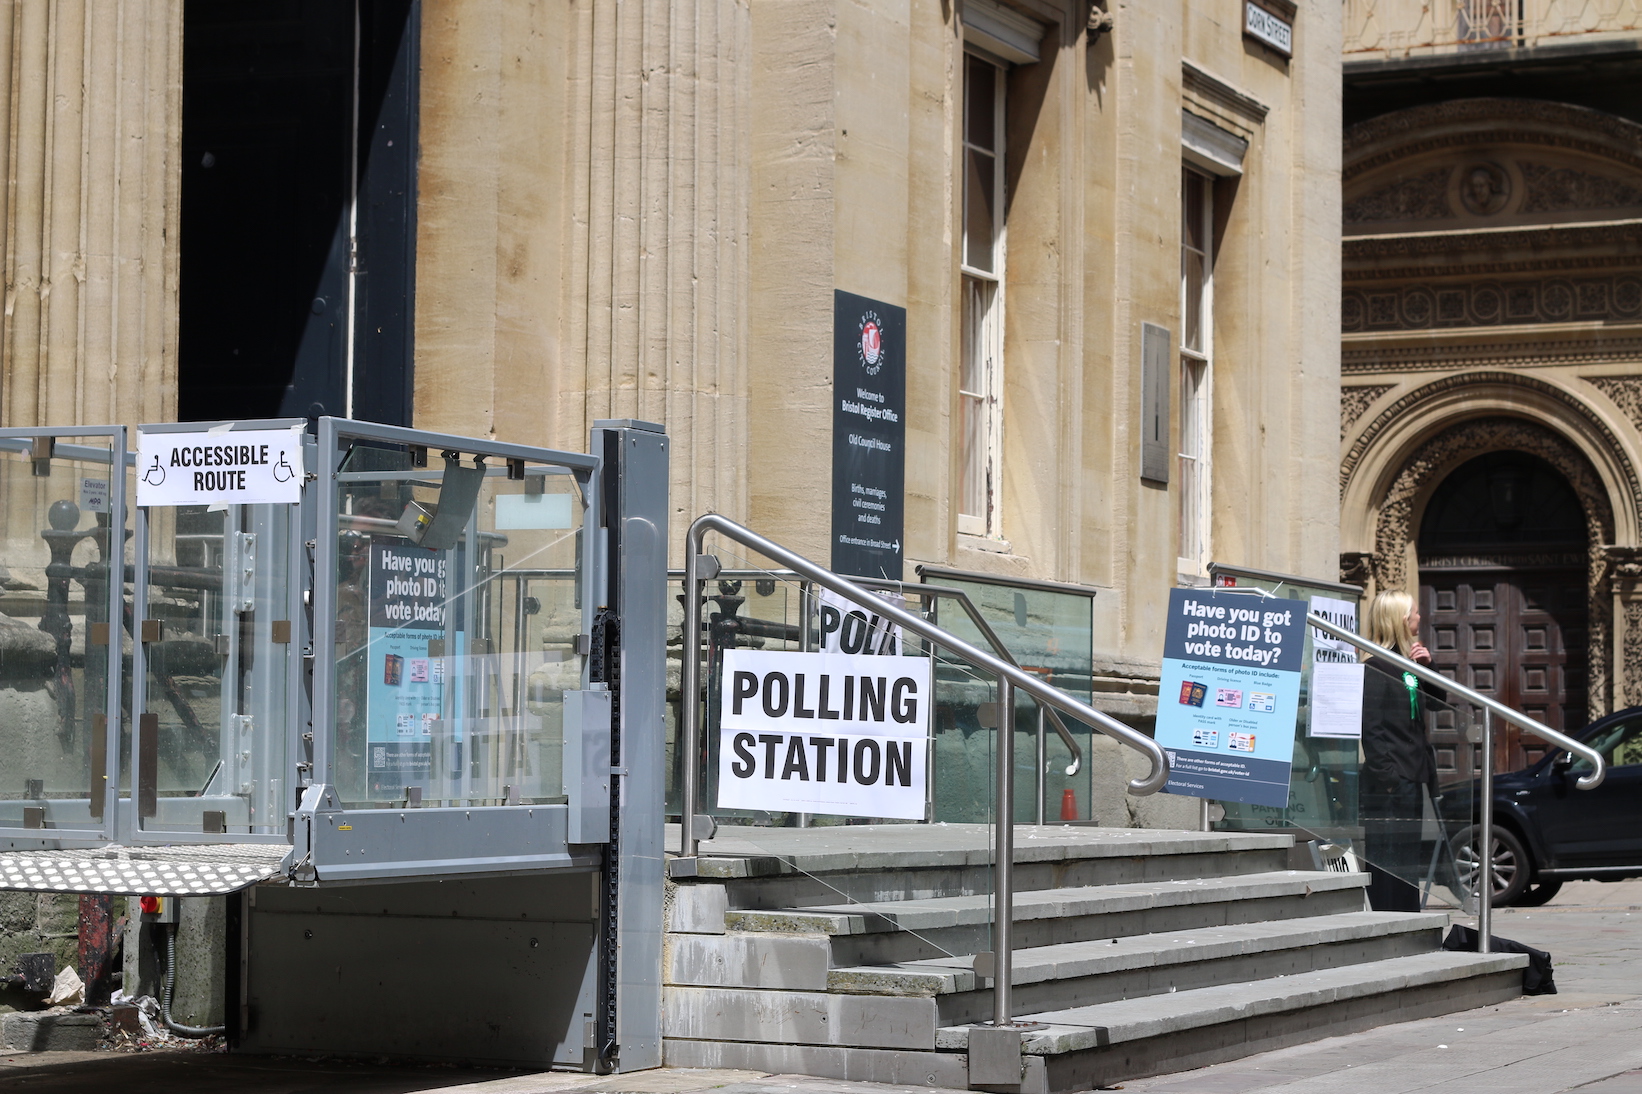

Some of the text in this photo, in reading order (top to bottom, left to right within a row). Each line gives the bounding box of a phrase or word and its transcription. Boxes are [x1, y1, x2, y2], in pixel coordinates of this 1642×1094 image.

[1248, 6, 1289, 47] CORN STREET
[859, 310, 884, 335] BRISTOL
[857, 342, 885, 376] CITY COUNCIL
[856, 387, 885, 403] Welcome to
[842, 400, 898, 422] Bristol Register Office
[849, 434, 891, 451] Old Council House
[170, 445, 268, 467] ACCESSIBLE
[84, 480, 106, 489] Elevator
[194, 470, 246, 491] ROUTE
[851, 483, 887, 499] Births, marriages,
[853, 498, 885, 511] civil ceremonies
[858, 513, 881, 524] and deaths
[840, 535, 850, 544] Office
[851, 537, 866, 546] entrance
[871, 539, 880, 548] Broad
[881, 540, 891, 549] Street
[382, 550, 412, 571] Have
[414, 558, 435, 577] you
[386, 575, 420, 599] photo
[424, 578, 437, 597] ID
[385, 601, 445, 626] vote today
[1183, 600, 1291, 628] Have you got
[1187, 620, 1282, 644] photo ID to
[1185, 641, 1281, 666] vote today?
[1182, 663, 1211, 672] Acceptable
[1235, 669, 1250, 677] photo
[1259, 671, 1280, 679] include:
[732, 670, 918, 724] POLLING
[732, 732, 912, 787] STATION
